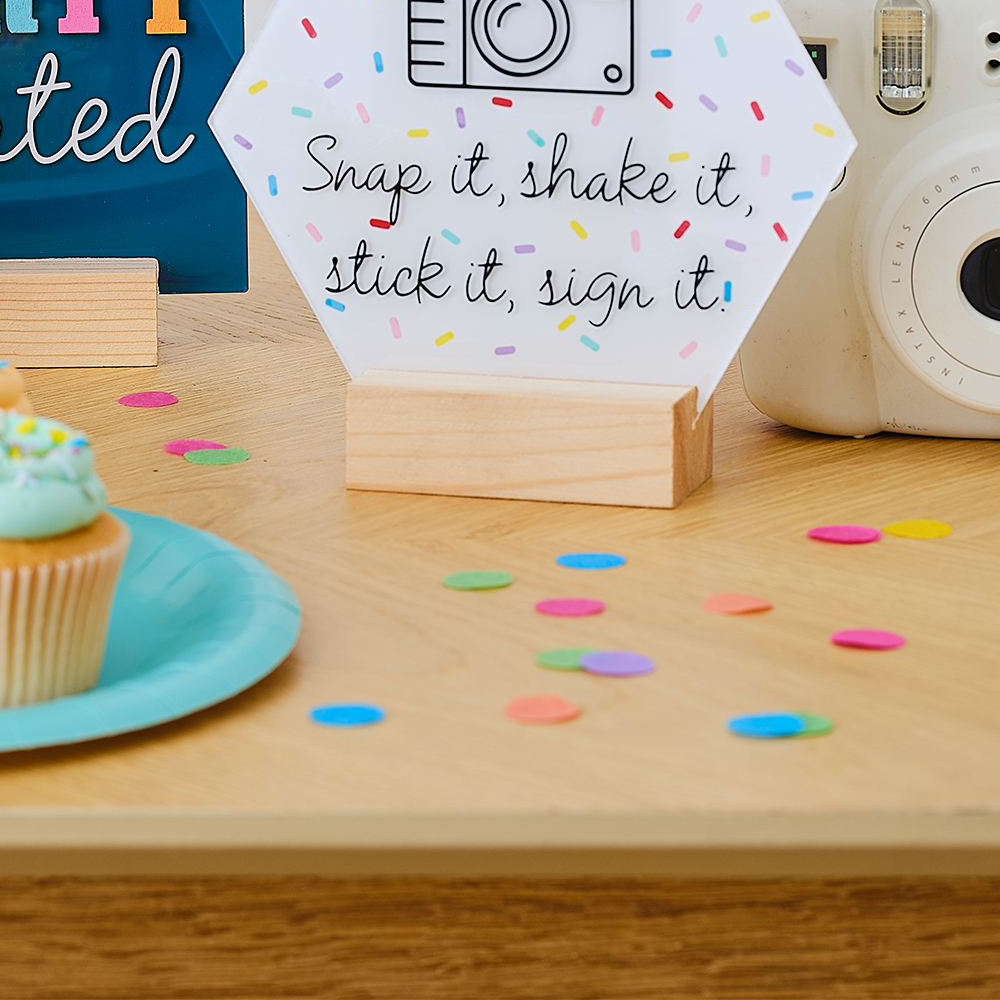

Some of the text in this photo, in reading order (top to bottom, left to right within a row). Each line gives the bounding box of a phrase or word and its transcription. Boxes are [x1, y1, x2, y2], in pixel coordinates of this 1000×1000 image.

[302, 132, 754, 226] Snap it, shake it,
[325, 236, 452, 304] stick
[465, 247, 516, 314] it,
[537, 268, 655, 328] sign
[891, 223, 912, 284] LENS
[896, 308, 964, 386] INSTAX
